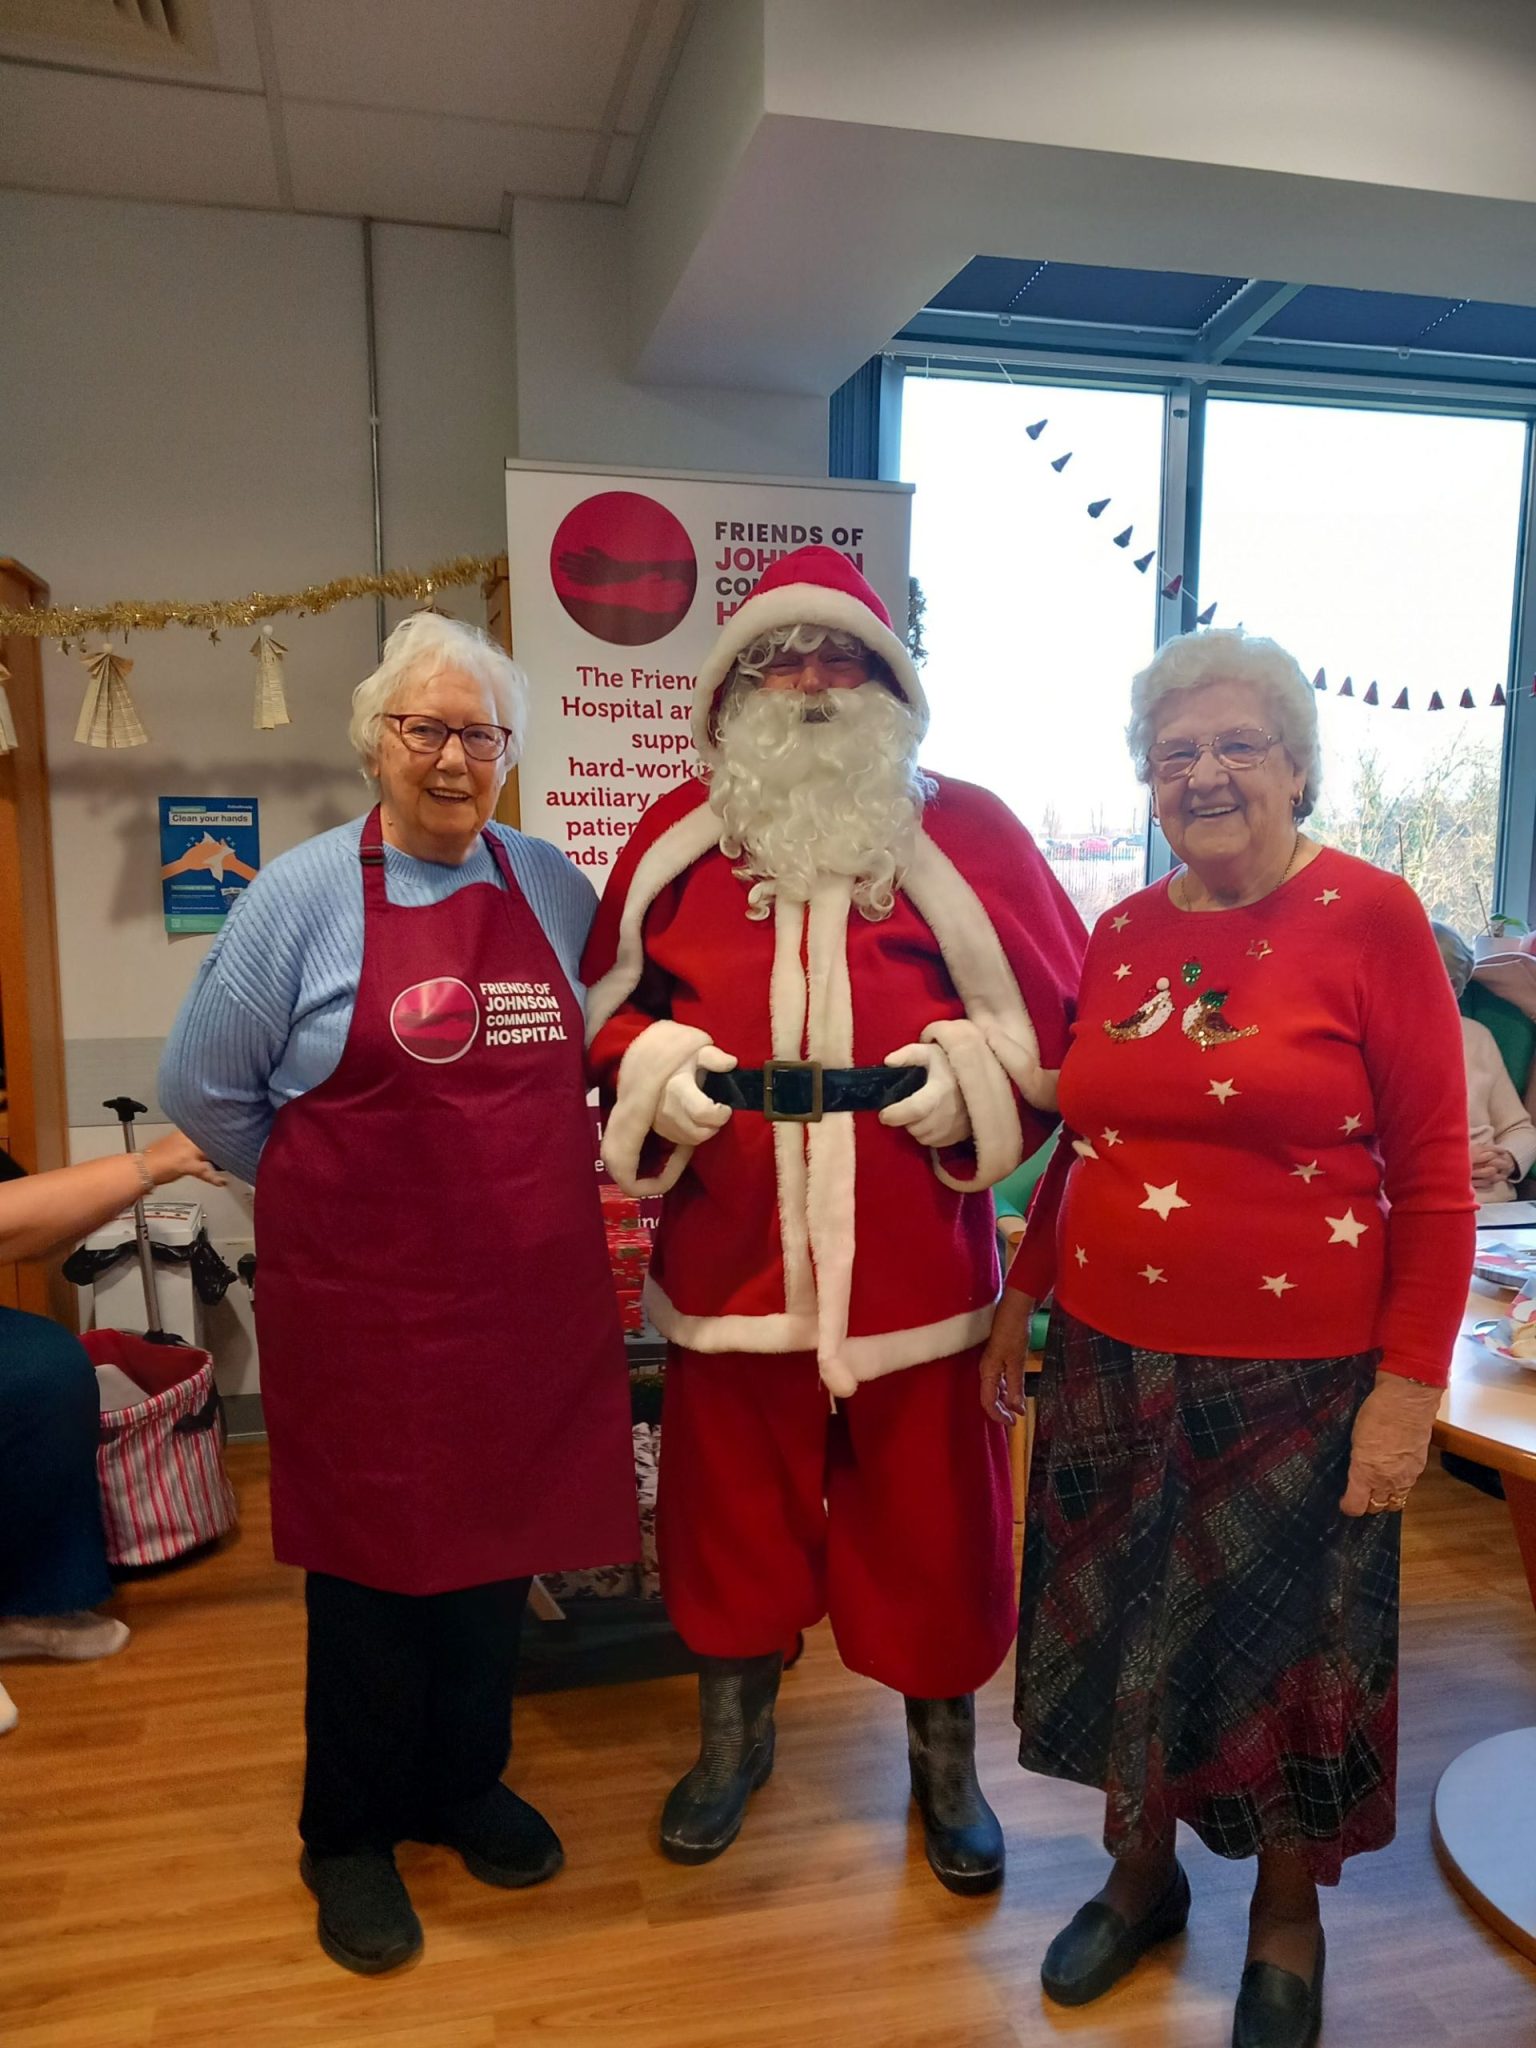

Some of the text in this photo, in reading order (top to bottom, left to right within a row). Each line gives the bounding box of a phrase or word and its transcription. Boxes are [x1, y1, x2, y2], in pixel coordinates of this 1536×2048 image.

[715, 521, 864, 547] FRIENDS OF
[715, 546, 864, 576] JOHN
[576, 666, 623, 688] The
[561, 696, 693, 723] Hospital ar
[546, 787, 651, 812] auxiliary
[172, 814, 248, 823] Clean your hands
[565, 845, 609, 865] nds
[479, 983, 551, 995] FRIENDS OF
[485, 997, 559, 1011] JOHNSON
[486, 1012, 561, 1026] COMMUNITY
[486, 1026, 567, 1046] HOSPITAL
